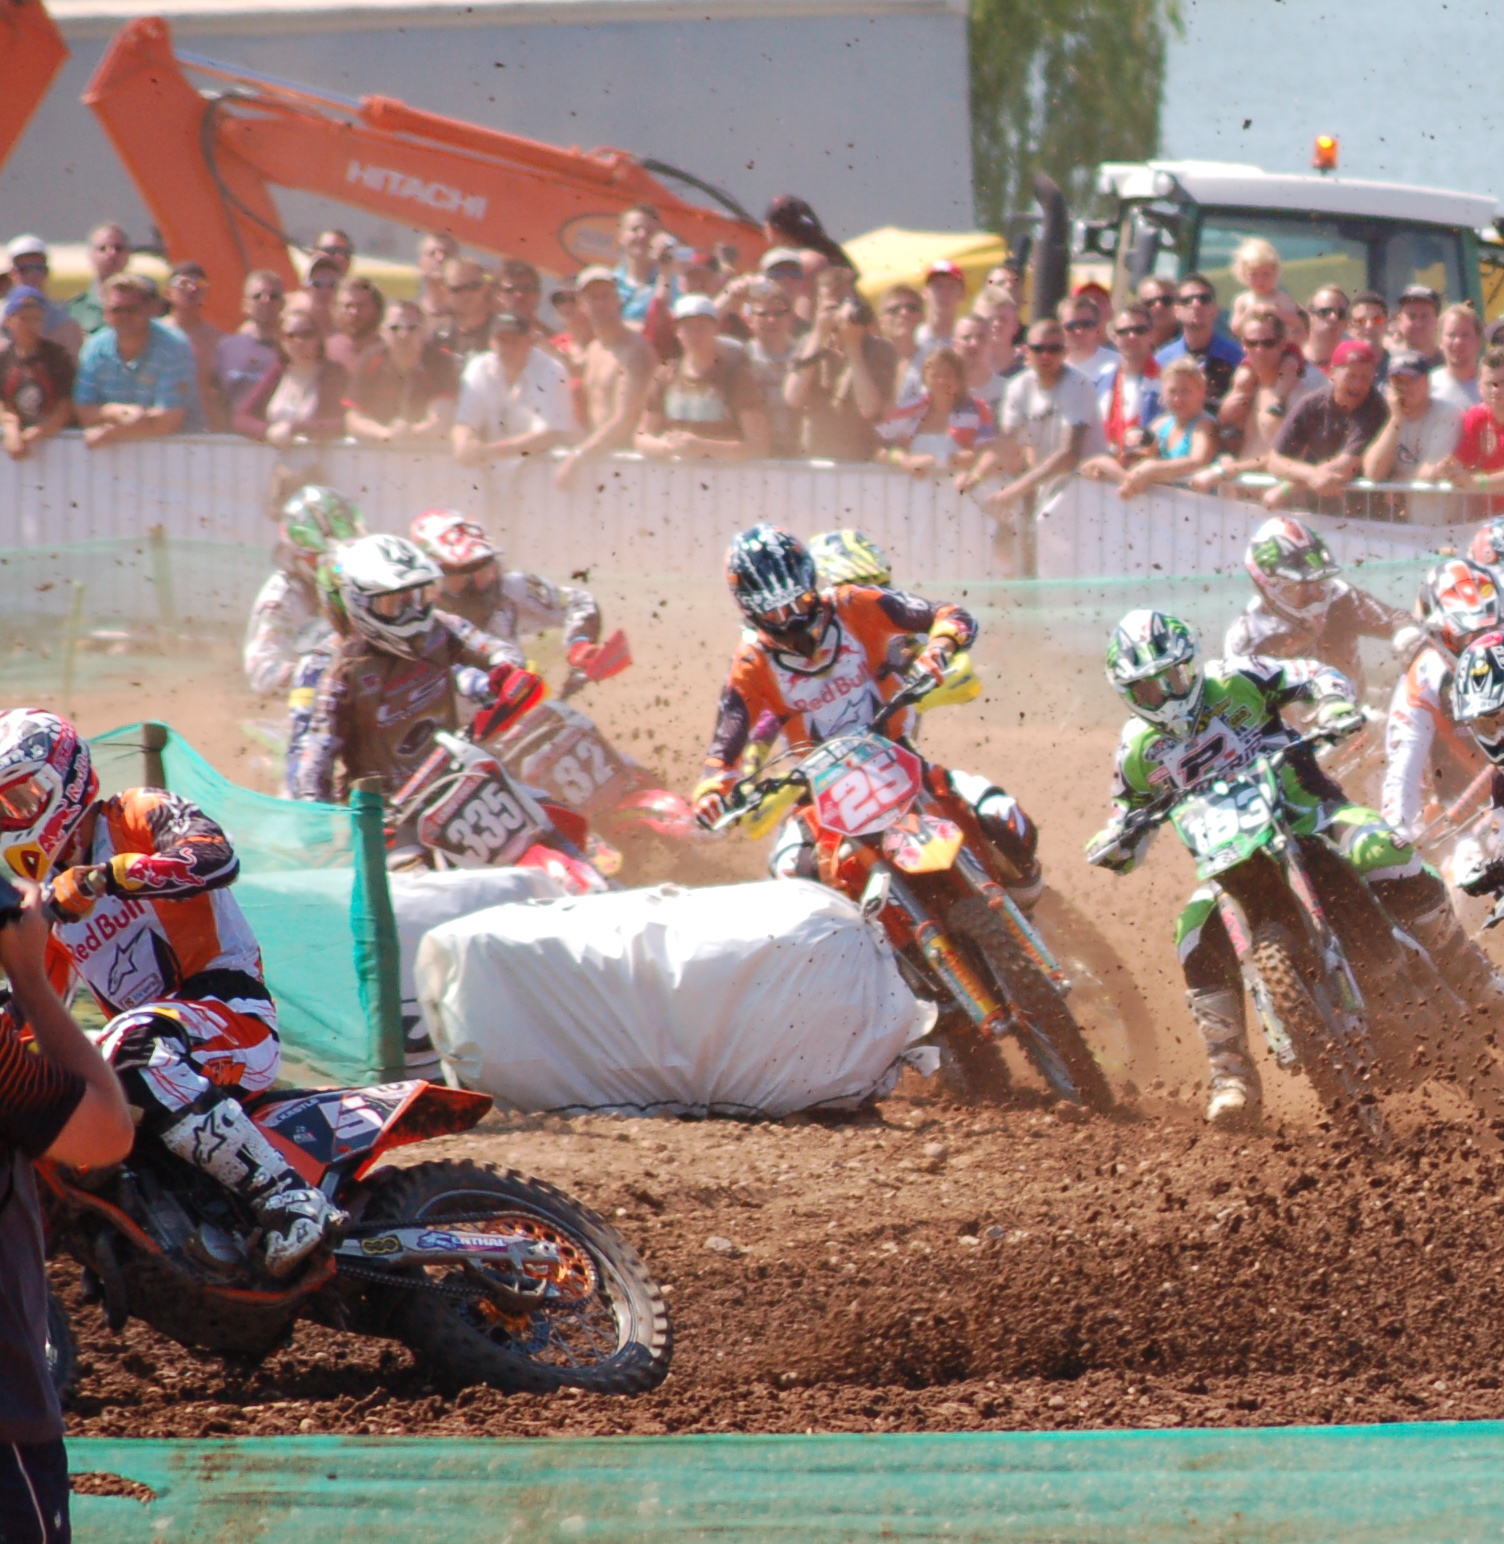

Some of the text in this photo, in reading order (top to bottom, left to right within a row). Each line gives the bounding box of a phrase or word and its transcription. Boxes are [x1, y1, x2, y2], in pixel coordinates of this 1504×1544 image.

[346, 159, 488, 221] HITACHI
[793, 660, 869, 713] Red Bull
[553, 738, 615, 805] 82
[830, 749, 913, 831] 25
[446, 781, 525, 865] 335
[94, 900, 146, 941] Bull
